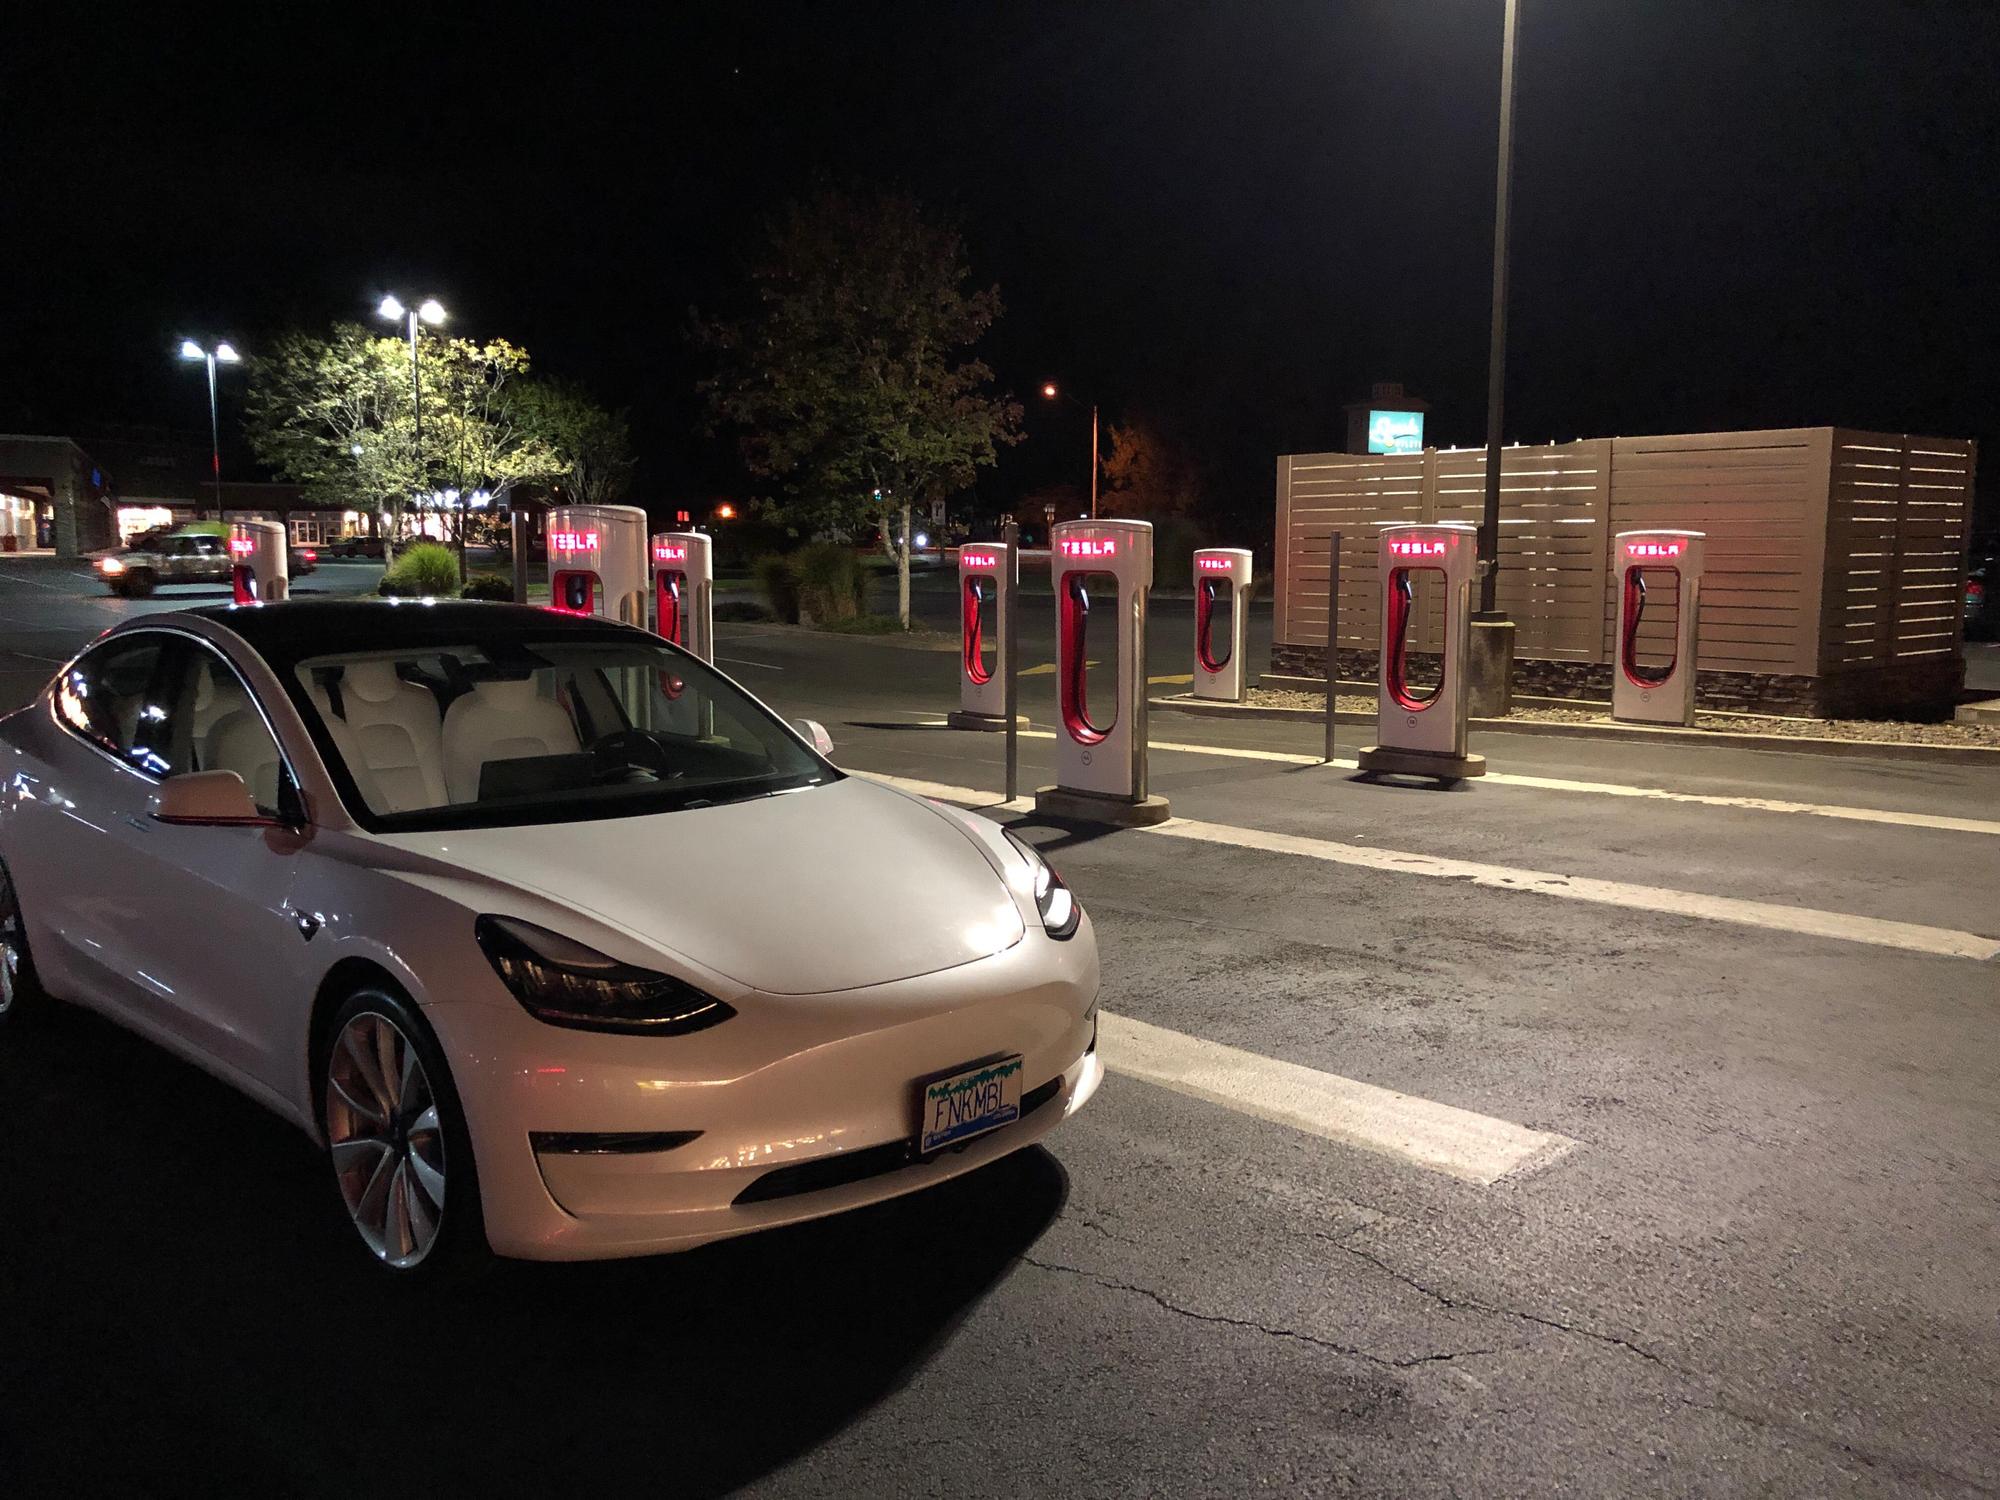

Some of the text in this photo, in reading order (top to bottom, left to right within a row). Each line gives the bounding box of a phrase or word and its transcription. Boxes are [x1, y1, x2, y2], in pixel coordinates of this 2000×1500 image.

[551, 533, 598, 550] TESLA
[655, 548, 685, 558] TESLA
[1061, 541, 1115, 555] TESLA
[1391, 542, 1445, 554] TESLA
[1627, 544, 1679, 555] TESLA
[964, 556, 995, 566] TESLA
[1199, 560, 1232, 569] TESLA
[934, 1079, 1010, 1130] FNKMBL
